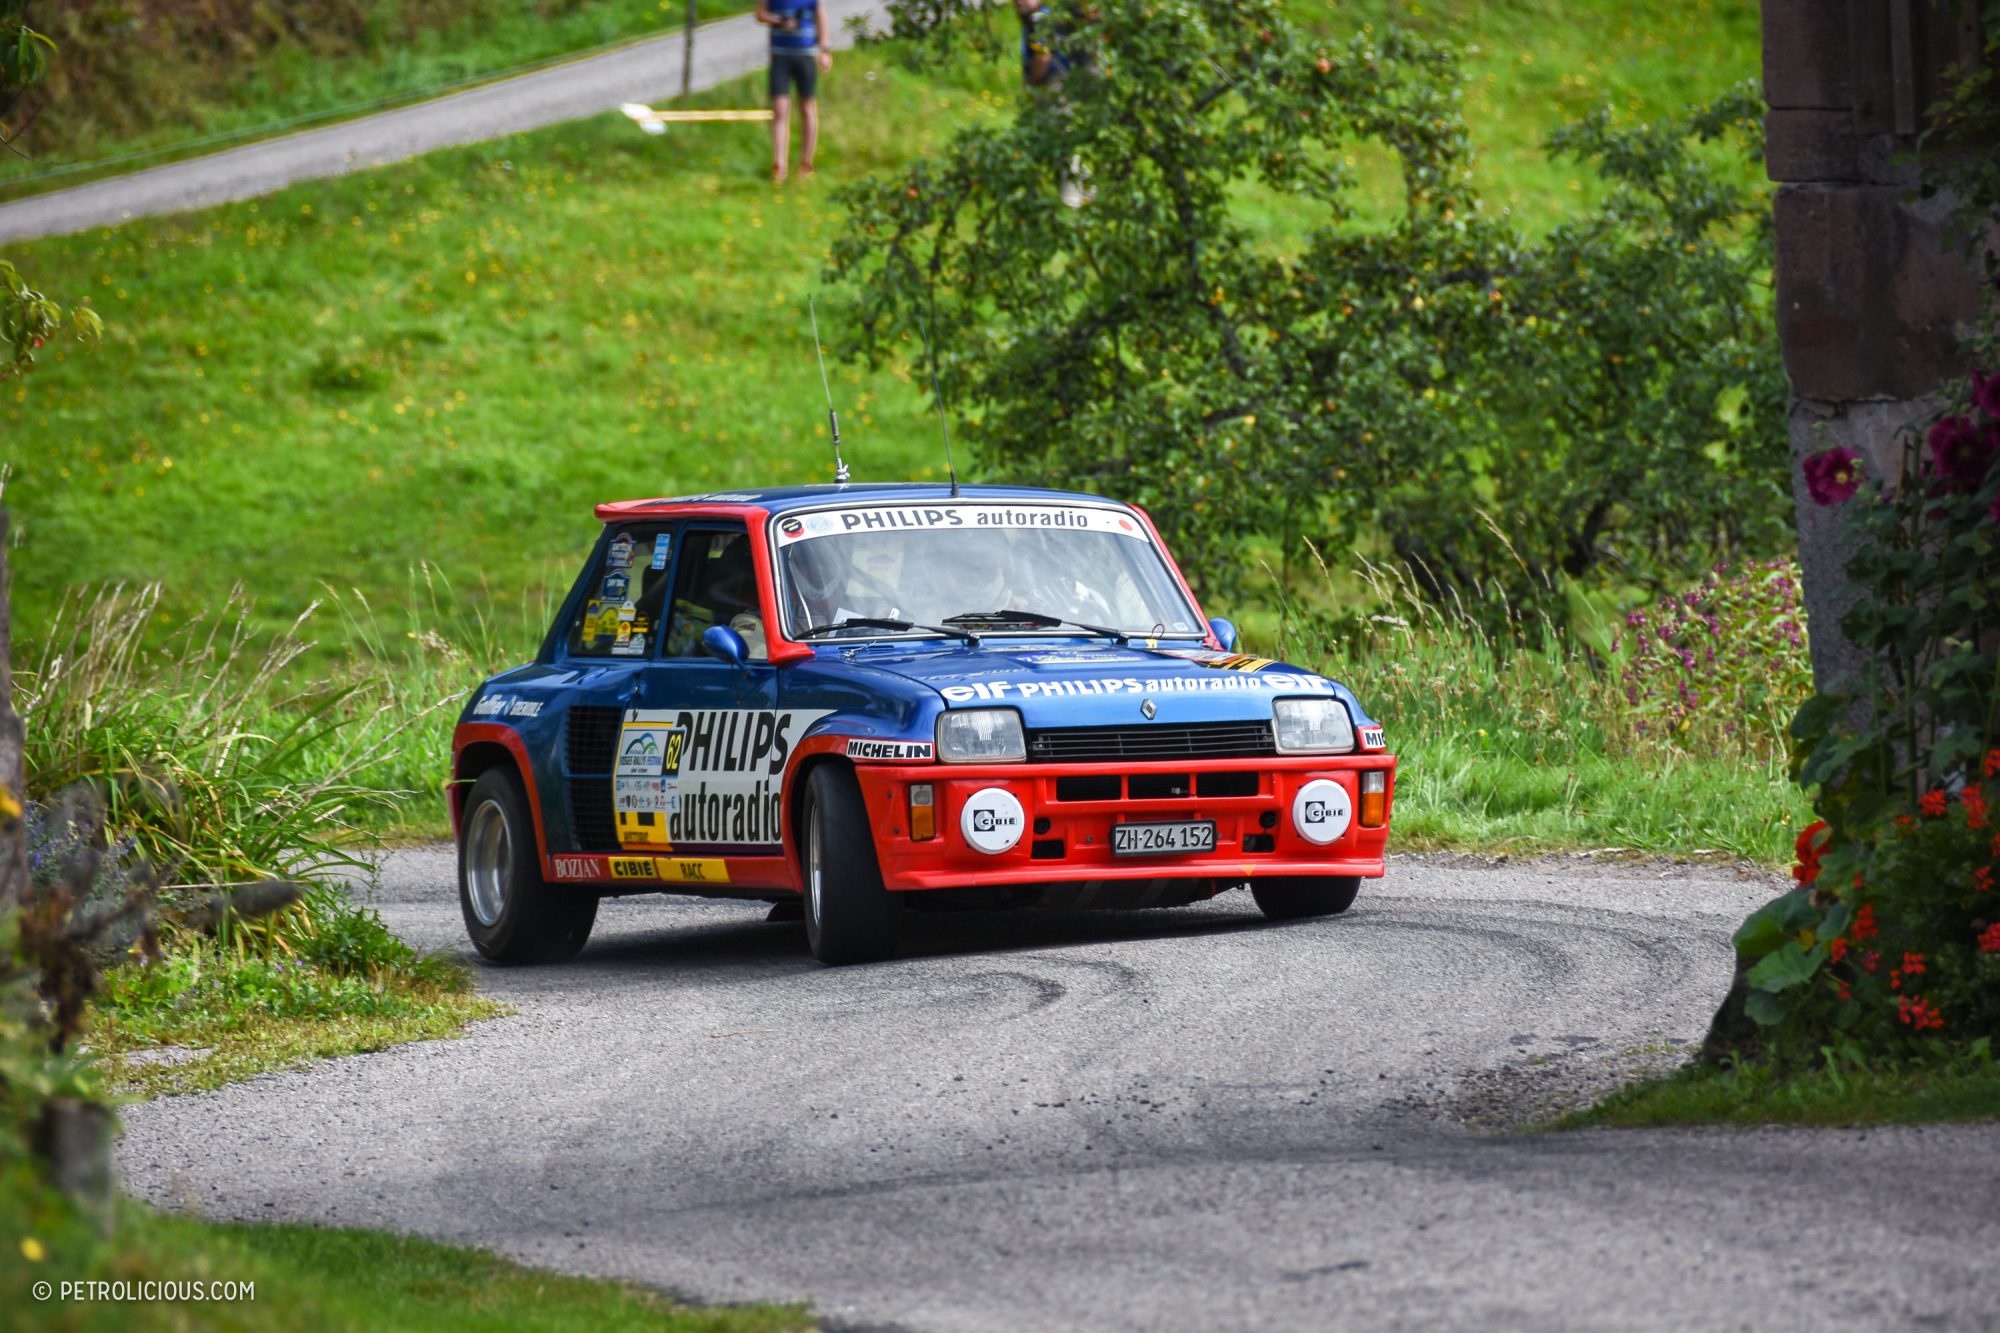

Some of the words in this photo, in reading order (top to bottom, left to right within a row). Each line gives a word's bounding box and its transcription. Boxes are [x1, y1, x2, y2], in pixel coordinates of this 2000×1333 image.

[841, 508, 964, 530] PHILIPS
[977, 509, 1089, 528] autoradio
[1016, 678, 1145, 699] PHILIPS
[1145, 676, 1261, 693] autoradio
[665, 733, 682, 770] 62
[847, 741, 931, 758] MICHELIN
[669, 780, 781, 842] autoradio
[555, 859, 601, 878] BOZIAN
